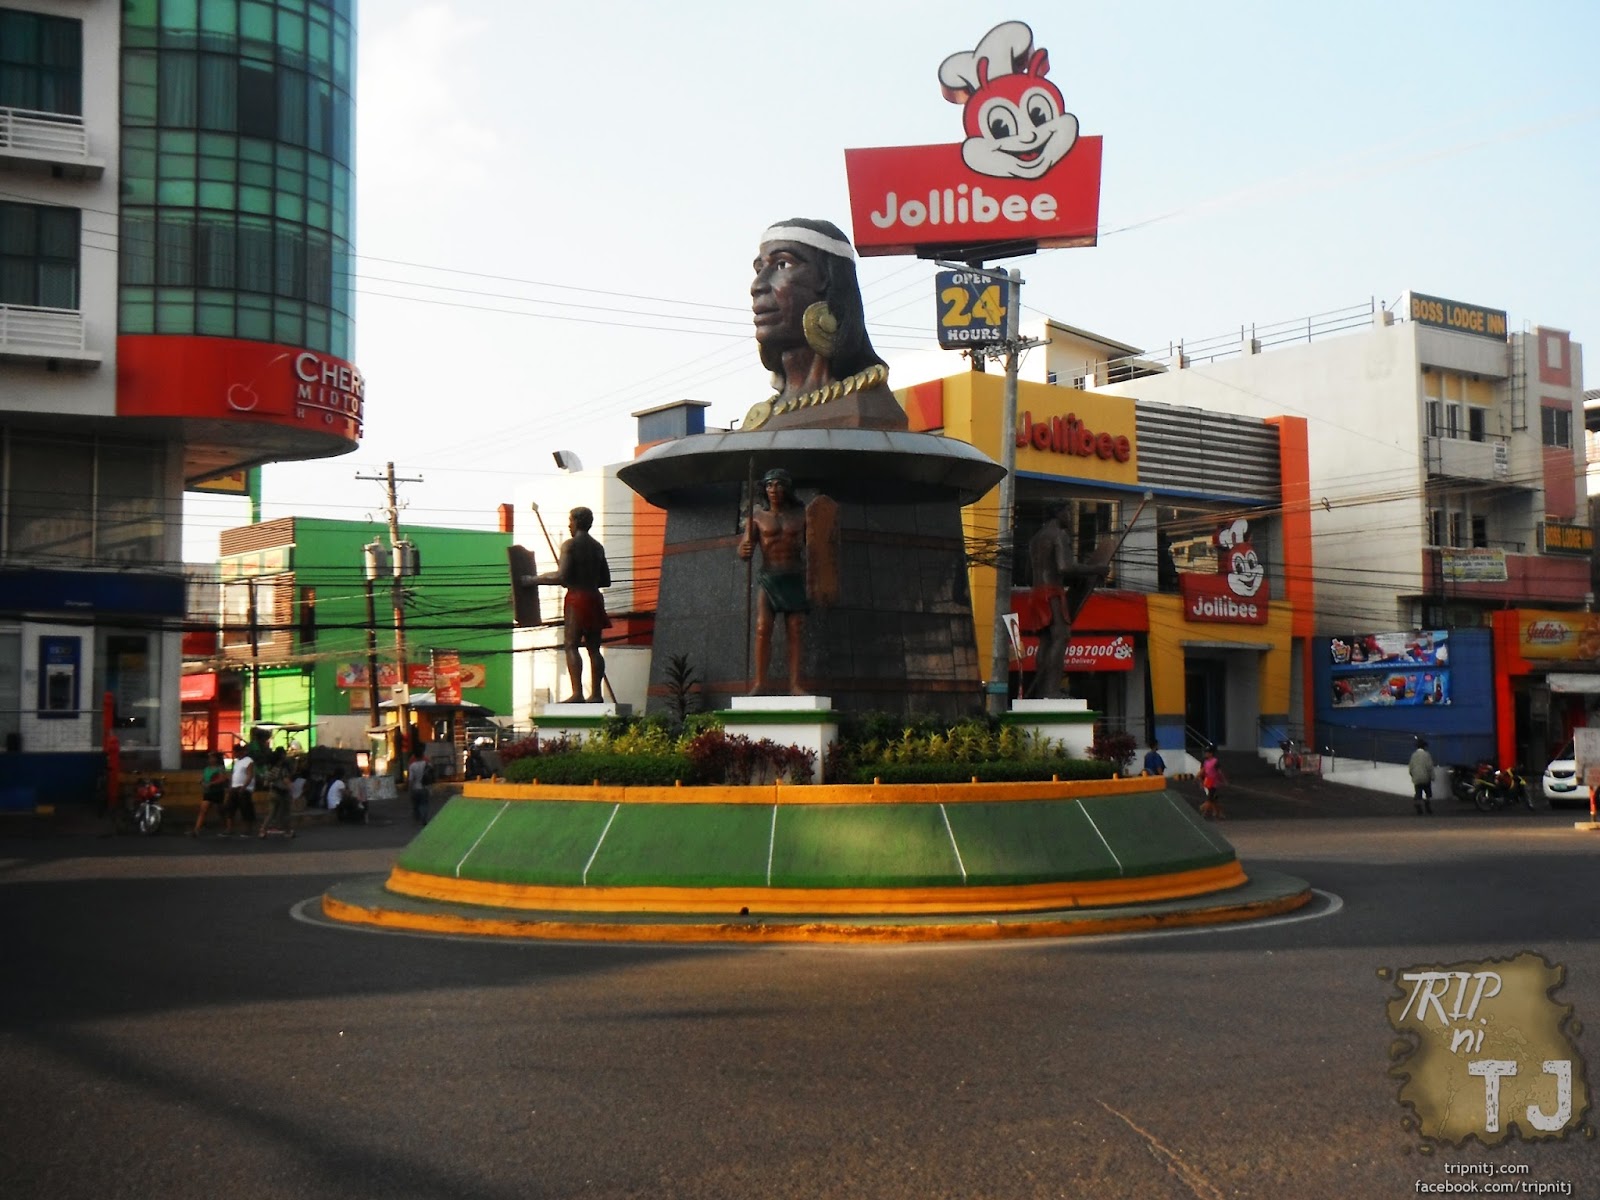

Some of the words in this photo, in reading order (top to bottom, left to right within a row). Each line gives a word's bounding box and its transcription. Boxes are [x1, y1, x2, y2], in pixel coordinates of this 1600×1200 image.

[870, 183, 1059, 229] Jollibee
[952, 272, 992, 285] OPEN
[941, 285, 1006, 327] 24
[1412, 298, 1444, 324] BOSS
[1447, 305, 1484, 332] LODGE
[1487, 313, 1505, 335] INN
[948, 328, 1000, 341] HOURS
[1015, 410, 1130, 463] Jollibee
[1193, 596, 1258, 618] Jollibee
[1071, 657, 1097, 665] Delivery
